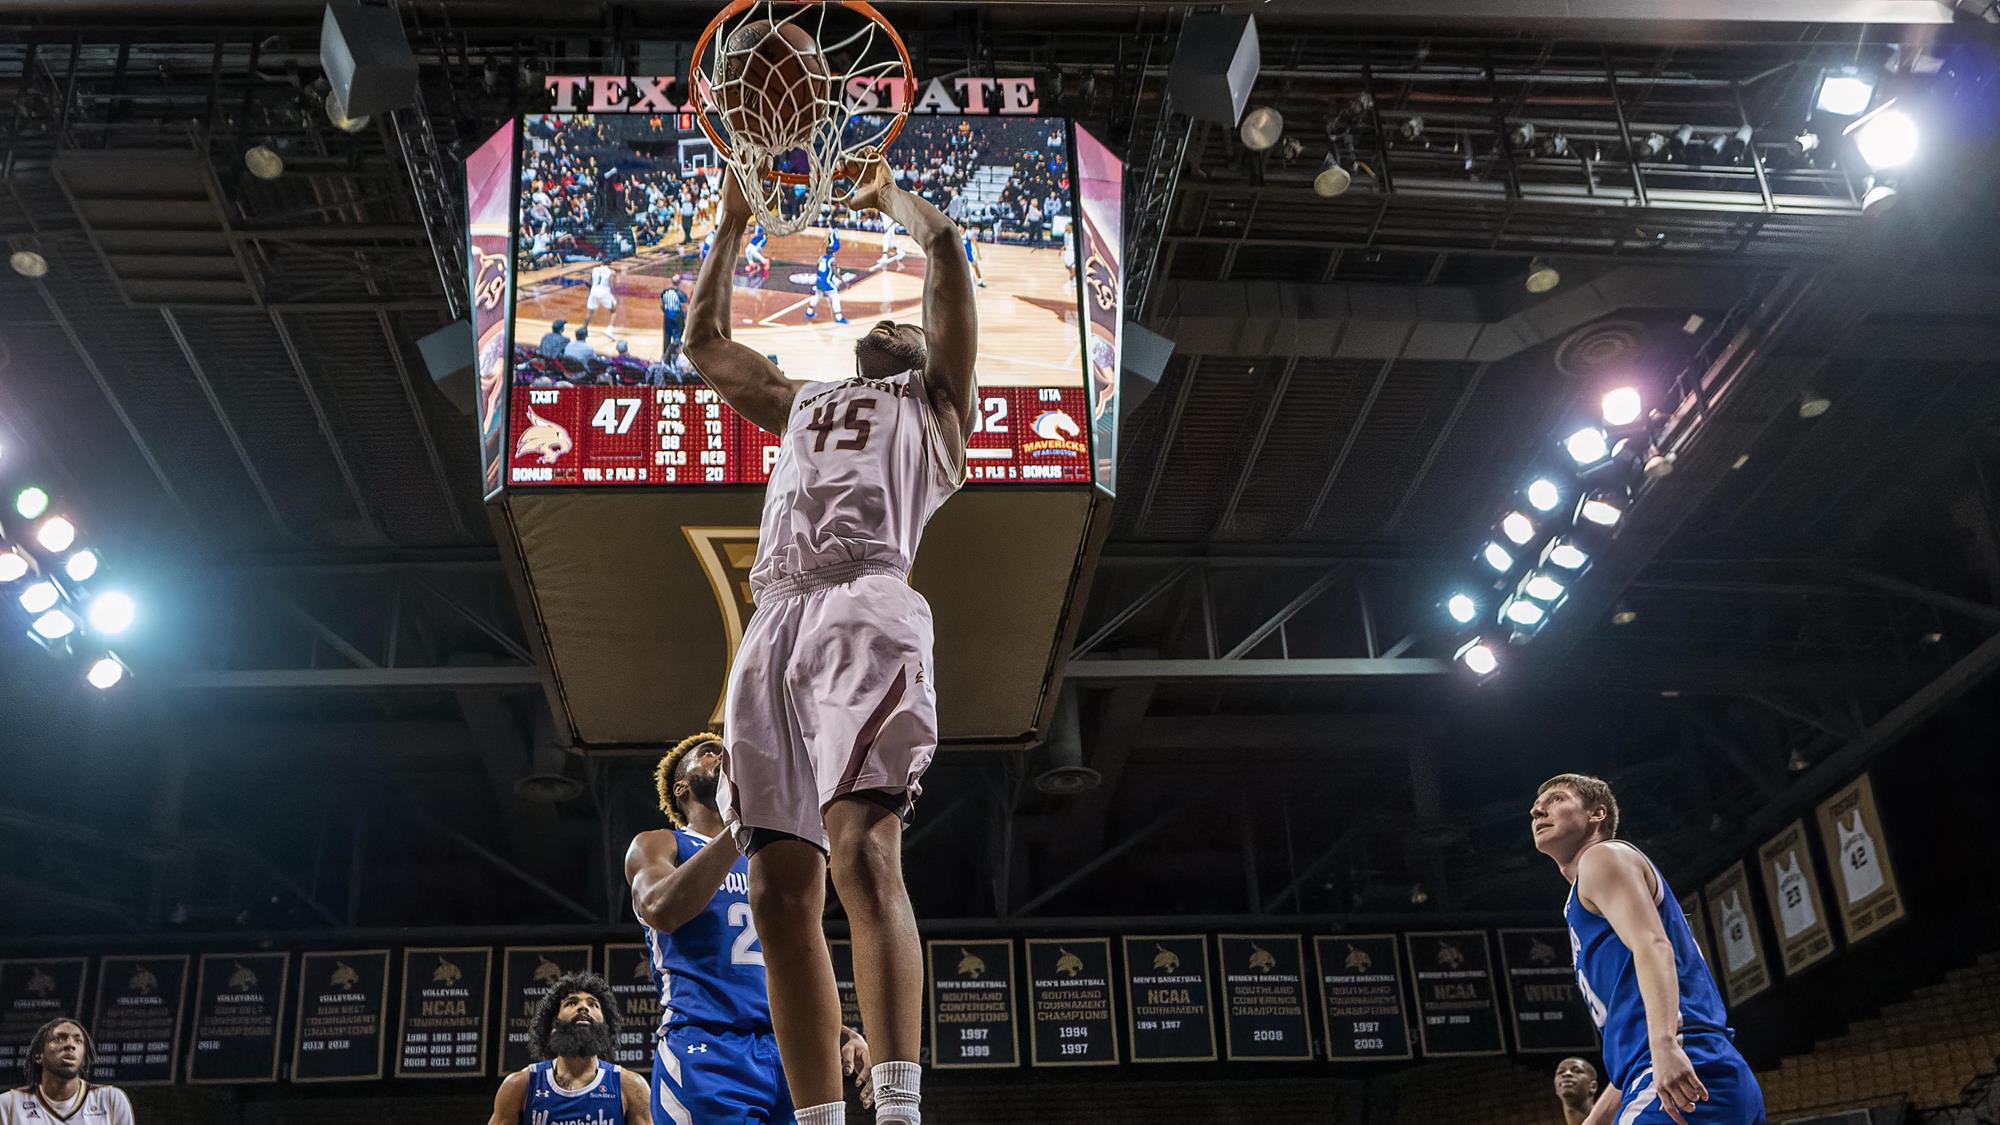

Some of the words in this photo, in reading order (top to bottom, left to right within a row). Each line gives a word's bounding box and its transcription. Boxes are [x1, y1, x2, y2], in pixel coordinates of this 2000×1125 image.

[545, 75, 719, 113] TEXA
[846, 76, 1039, 113] STATE
[529, 390, 560, 404] TXST
[1039, 388, 1061, 402] UTA
[591, 398, 642, 435] 47
[661, 404, 681, 419] 45
[705, 404, 720, 419] 31
[657, 420, 686, 435] FT%
[704, 420, 722, 435] TO
[807, 398, 876, 452] 45
[707, 435, 722, 449] 14
[1022, 440, 1087, 453] MAVERICKS
[655, 451, 687, 465] STLS
[512, 467, 553, 482] BONUS
[582, 468, 603, 481] TOL
[605, 468, 615, 481] 2
[665, 467, 676, 482] 3
[705, 467, 724, 482] 20
[1008, 466, 1017, 479] 5
[1023, 465, 1062, 479] BONUS
[937, 981, 960, 989] MEN'S
[962, 980, 1008, 988] BASKETBALL
[1060, 979, 1106, 987] BASKETBALL
[1133, 976, 1156, 984] MEN'S
[1157, 975, 1202, 983] BASKETBALL
[422, 989, 470, 997] VOLLEYBALL
[1041, 990, 1102, 1000] SOUTHLAND
[1234, 985, 1294, 994] SOUTHLAND
[942, 992, 1003, 1001] SOUTHLAND
[1147, 989, 1191, 1005] NCAA
[422, 1000, 466, 1016] NCAA
[940, 1002, 1006, 1011] CONFERENCE
[1037, 1000, 1106, 1010] TOURNAMENT
[1136, 1006, 1204, 1015] TOURNAMENT
[1232, 1006, 1301, 1016] CHAMPIONS
[938, 1012, 1009, 1022] CHAMPIONS
[1037, 1010, 1109, 1021] CHAMPIONS
[960, 1028, 989, 1040] 1997
[1059, 1027, 1088, 1038] 1994
[1253, 1030, 1283, 1041] 2008
[614, 1049, 644, 1062] 1960
[960, 1045, 990, 1057] 1999
[1060, 1043, 1089, 1055] 1997
